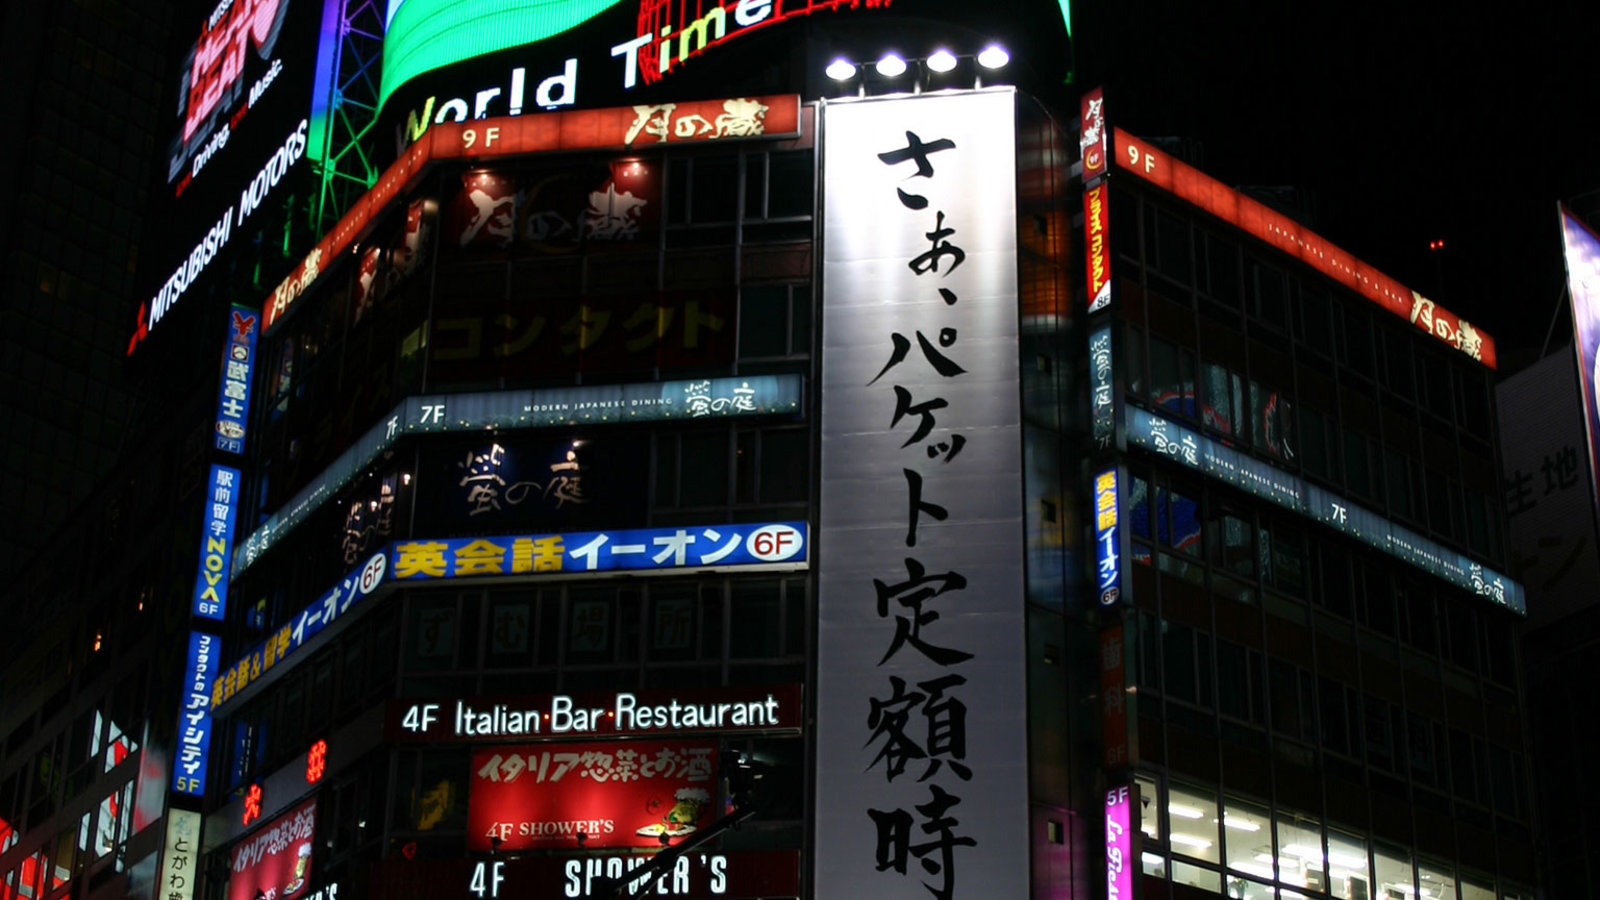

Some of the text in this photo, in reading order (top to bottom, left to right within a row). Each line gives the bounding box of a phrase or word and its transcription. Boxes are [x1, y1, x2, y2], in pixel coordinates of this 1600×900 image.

[611, 0, 773, 89] Time
[462, 128, 500, 149] 9F
[1128, 145, 1155, 173] 9F
[148, 119, 308, 331] MITSUBISHI MOTORS
[223, 359, 250, 419] 武富士
[420, 405, 446, 425] 7F
[523, 403, 569, 413] MODERN
[574, 400, 625, 411] JAPANESE
[631, 397, 673, 407] DINING
[1331, 503, 1347, 524] 7F
[395, 529, 795, 579] 英会話イーオン 6F
[362, 556, 384, 591] 6F
[199, 602, 218, 616] 6F
[401, 692, 780, 737] 4F Italian Bar Restaurant
[476, 746, 714, 785] イタリア惣菜とお酒
[176, 776, 201, 794] 5F
[1107, 786, 1129, 807] 5F
[518, 818, 615, 837] SHOWER'S
[470, 860, 505, 899] 4F
